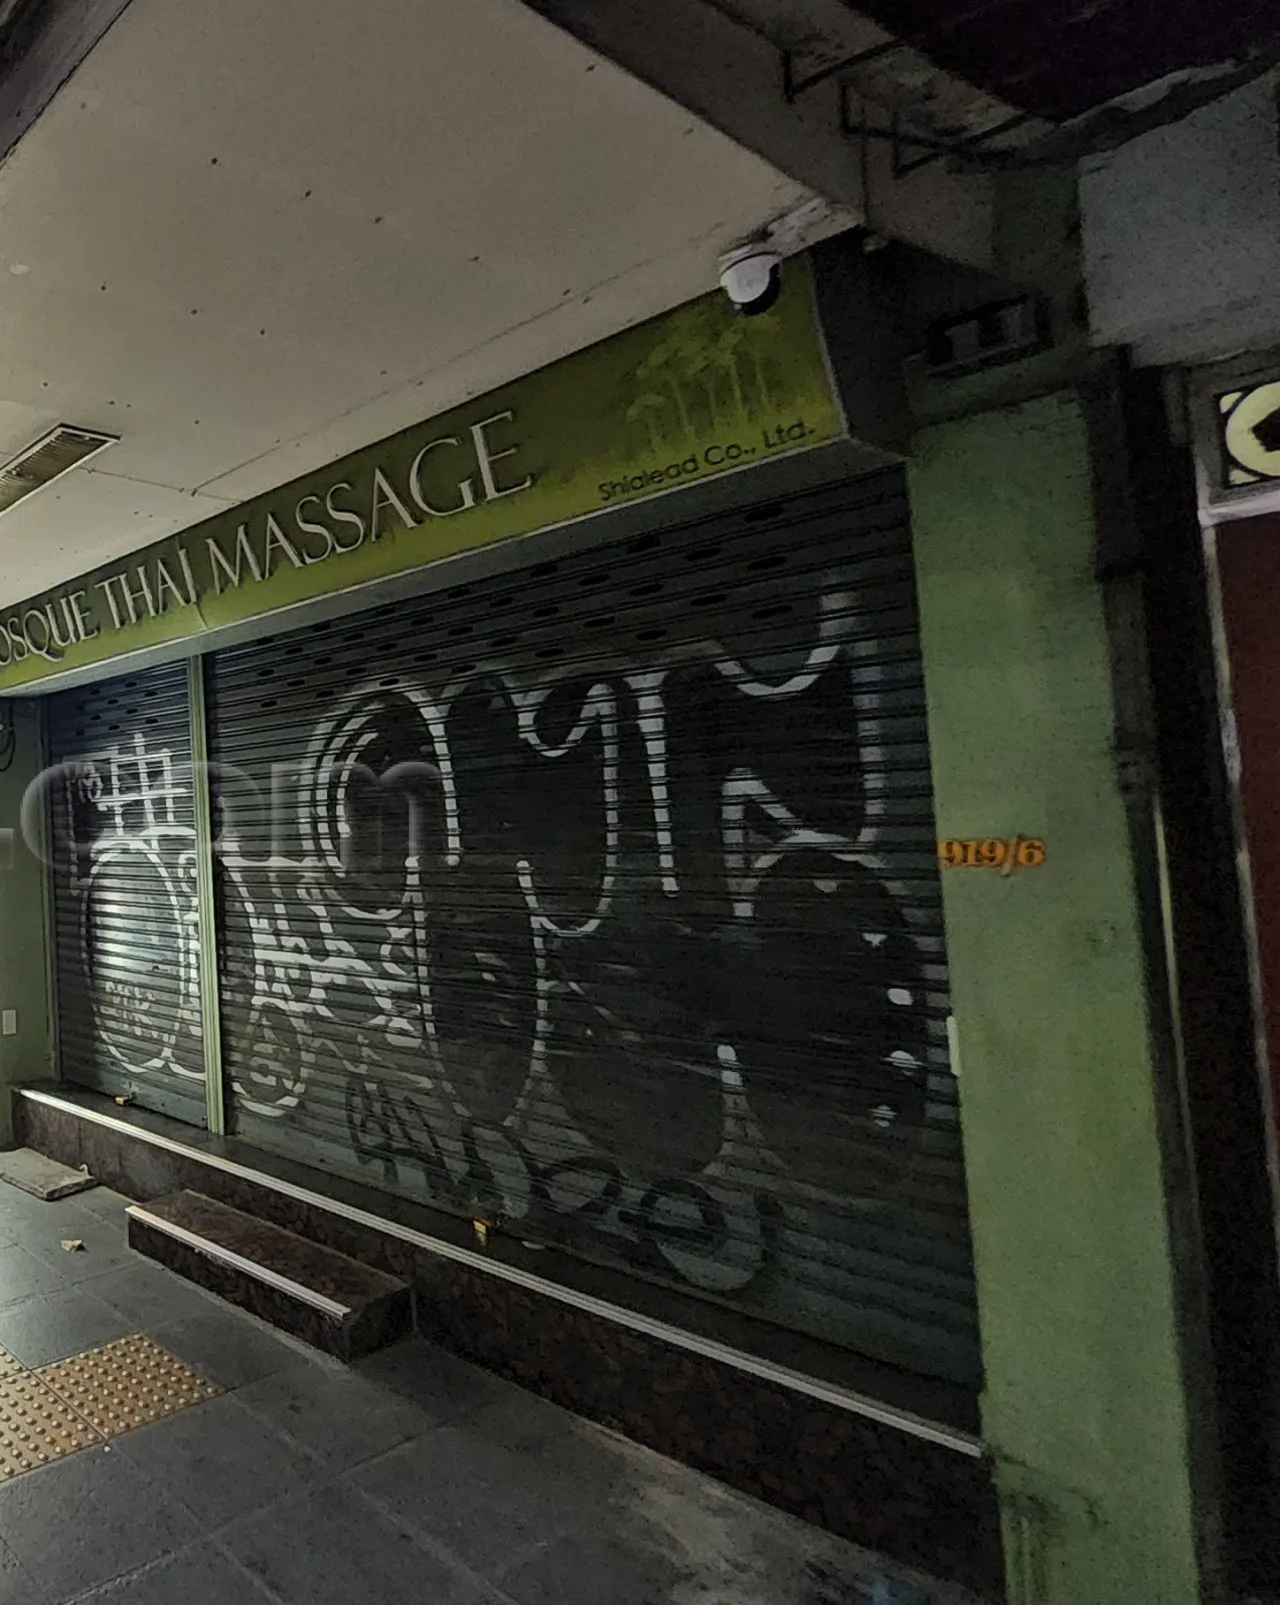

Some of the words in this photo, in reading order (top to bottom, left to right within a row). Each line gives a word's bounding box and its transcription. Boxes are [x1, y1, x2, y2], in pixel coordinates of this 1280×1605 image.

[761, 417, 817, 450] Ltd.
[94, 548, 198, 629] THAI
[205, 410, 536, 596] MASSAGE
[937, 836, 1046, 877] 919/6
